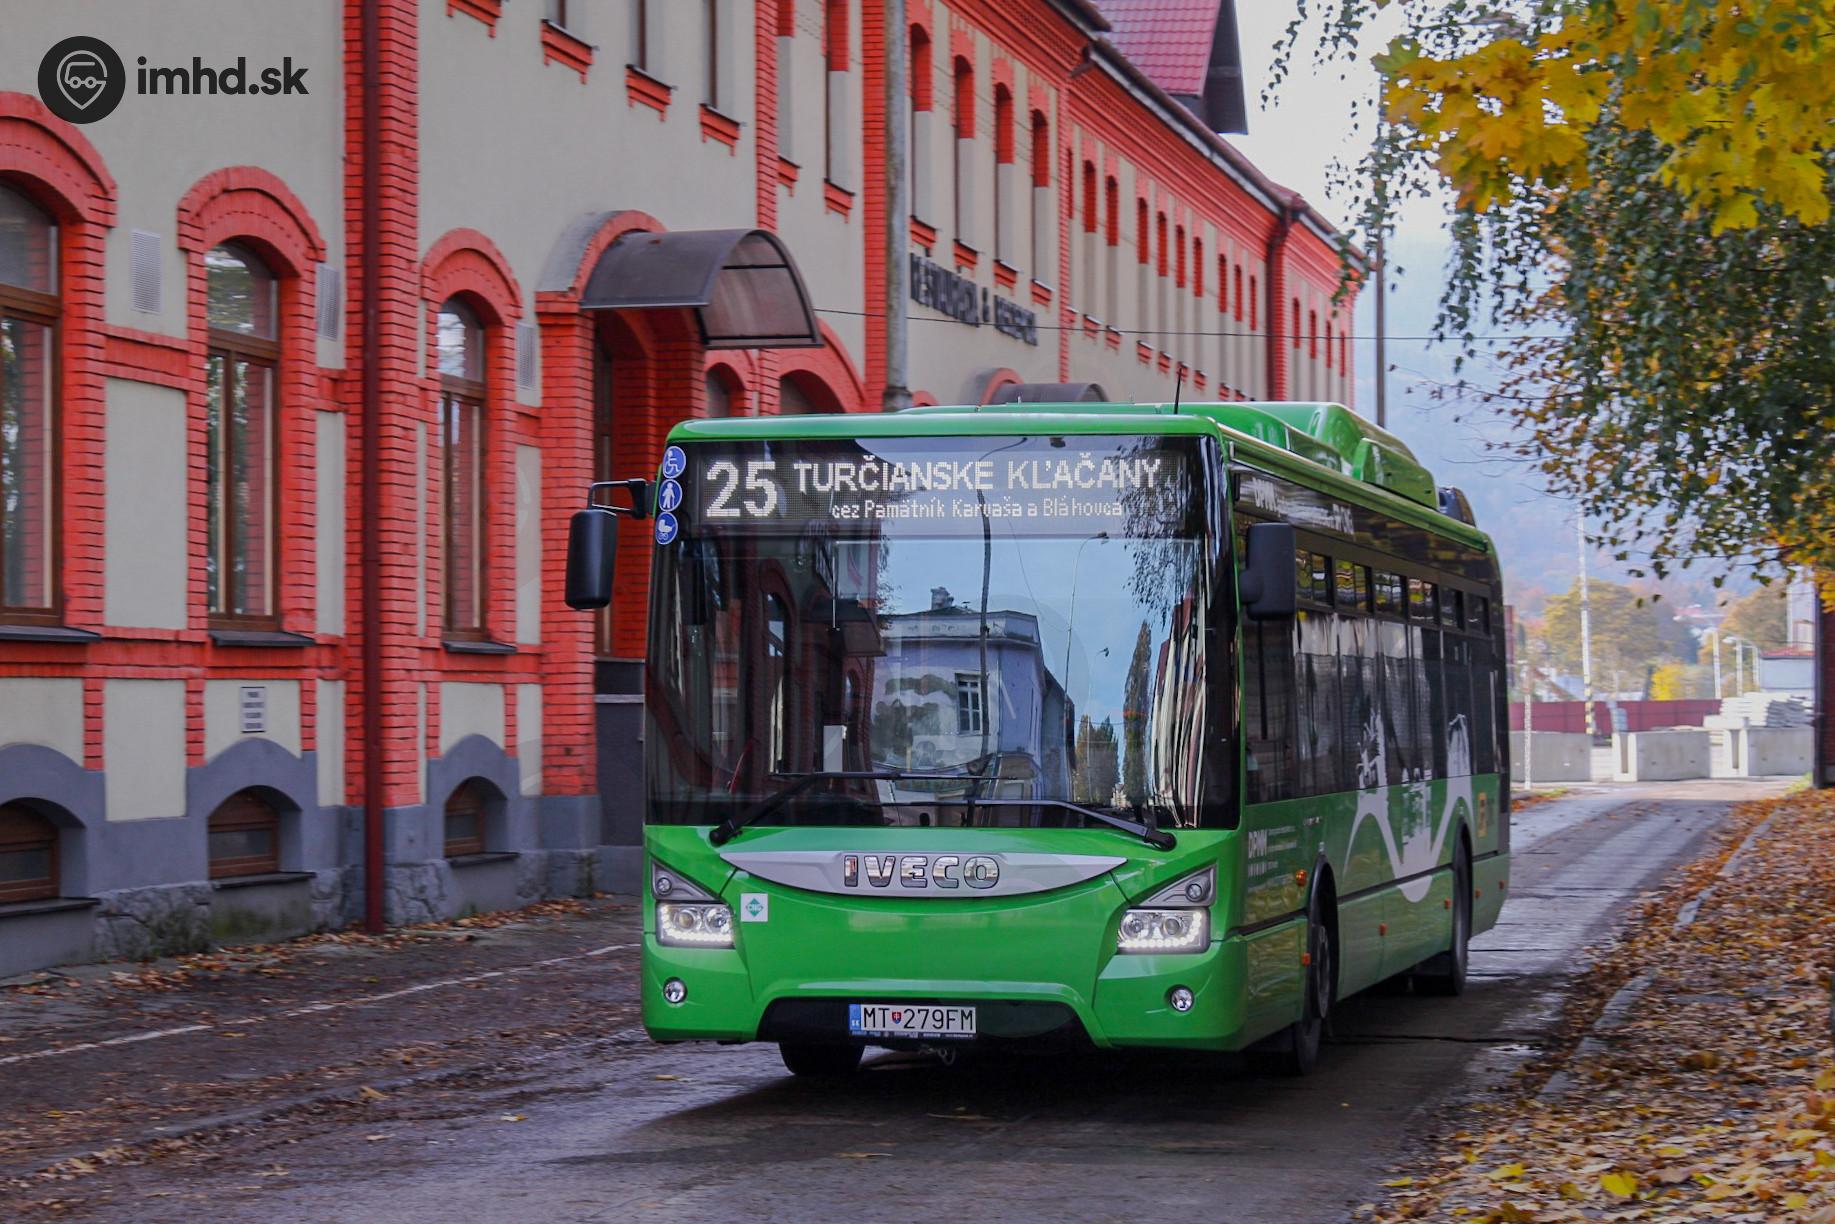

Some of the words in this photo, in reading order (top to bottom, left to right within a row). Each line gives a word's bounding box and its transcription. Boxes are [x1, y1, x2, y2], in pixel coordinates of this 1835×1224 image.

[706, 461, 778, 518] 25
[794, 454, 994, 492] TURČIANSKE
[832, 503, 860, 519] cez
[865, 497, 945, 519] Pamätník
[1027, 502, 1038, 517] a
[844, 856, 1000, 890] IVECO
[863, 1007, 890, 1029] MT
[903, 1008, 974, 1031] 279FM
